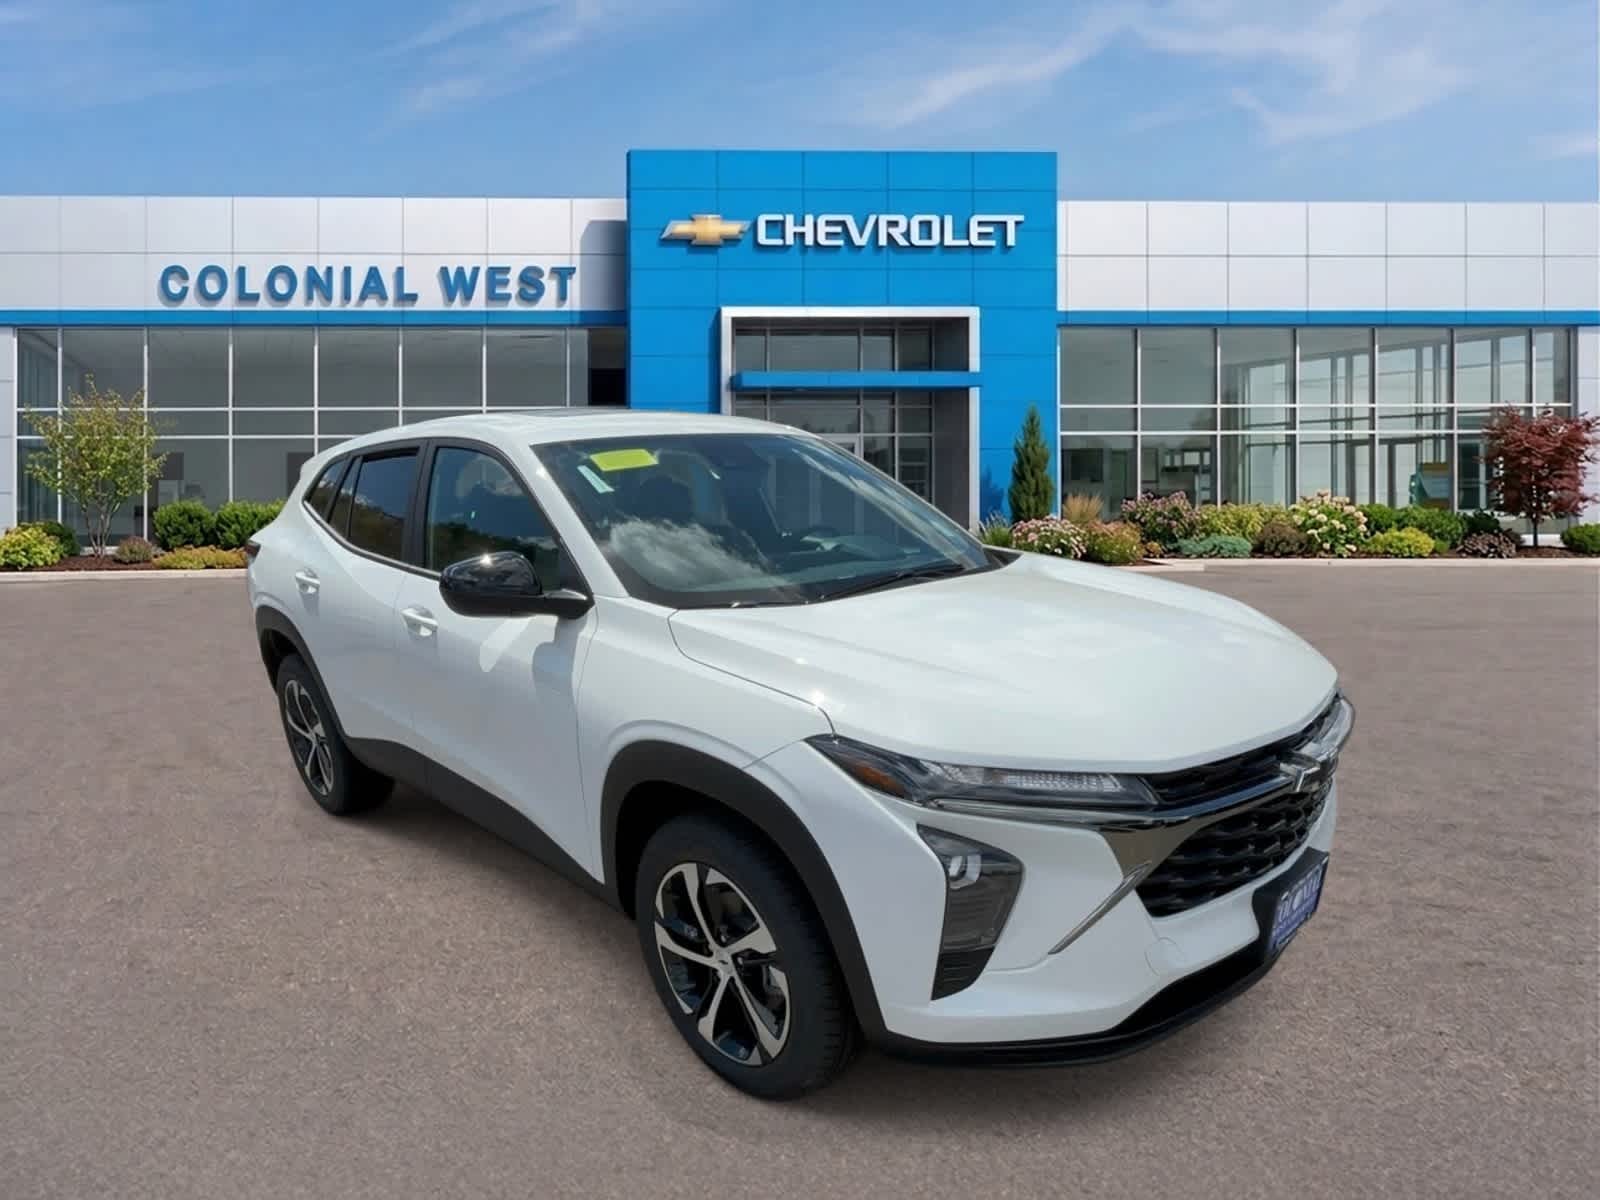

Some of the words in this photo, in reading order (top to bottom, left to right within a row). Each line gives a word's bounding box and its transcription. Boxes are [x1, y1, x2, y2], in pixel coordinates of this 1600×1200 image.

[757, 214, 1025, 247] CHEVROLET
[160, 265, 418, 304] COLONIAL
[439, 265, 577, 304] WEST
